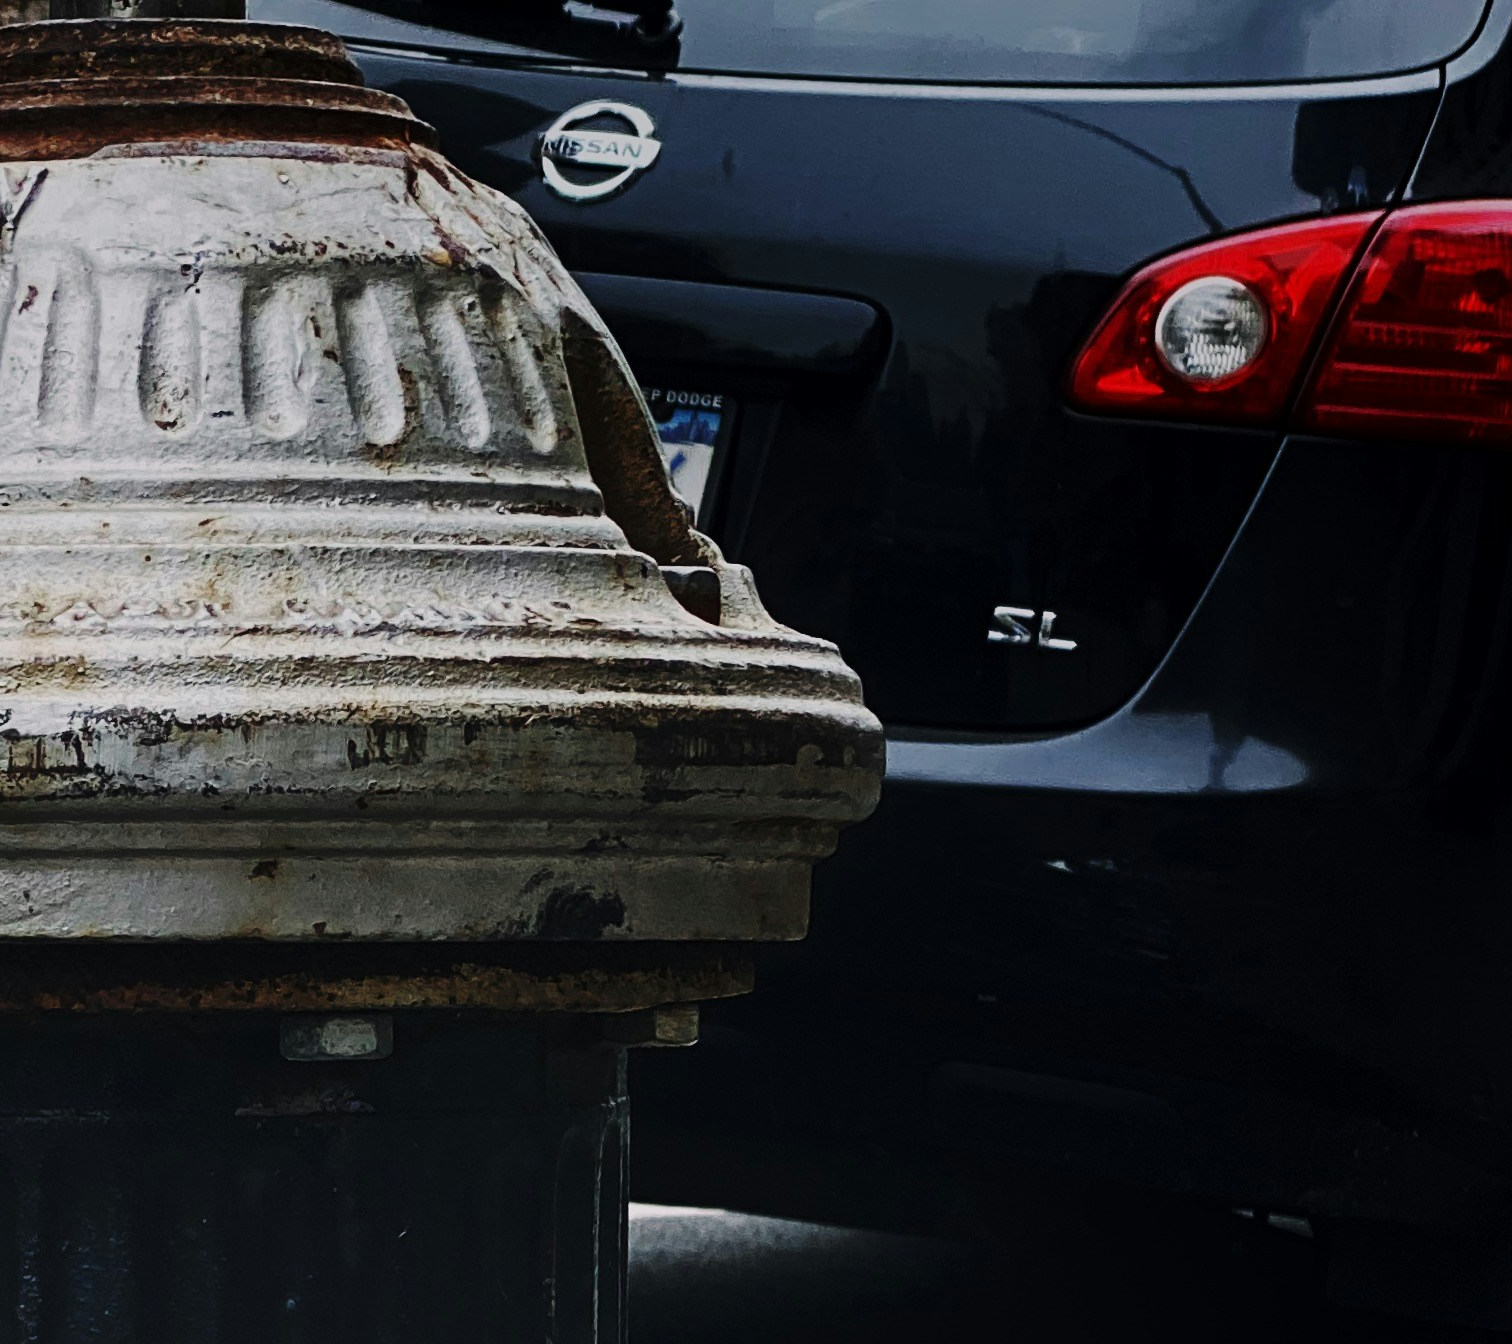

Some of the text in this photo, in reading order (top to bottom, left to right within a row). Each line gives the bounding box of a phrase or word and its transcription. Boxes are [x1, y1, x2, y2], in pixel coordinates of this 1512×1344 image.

[544, 135, 643, 158] NISSAN
[666, 389, 724, 409] DODGE
[987, 605, 1078, 650] SL
